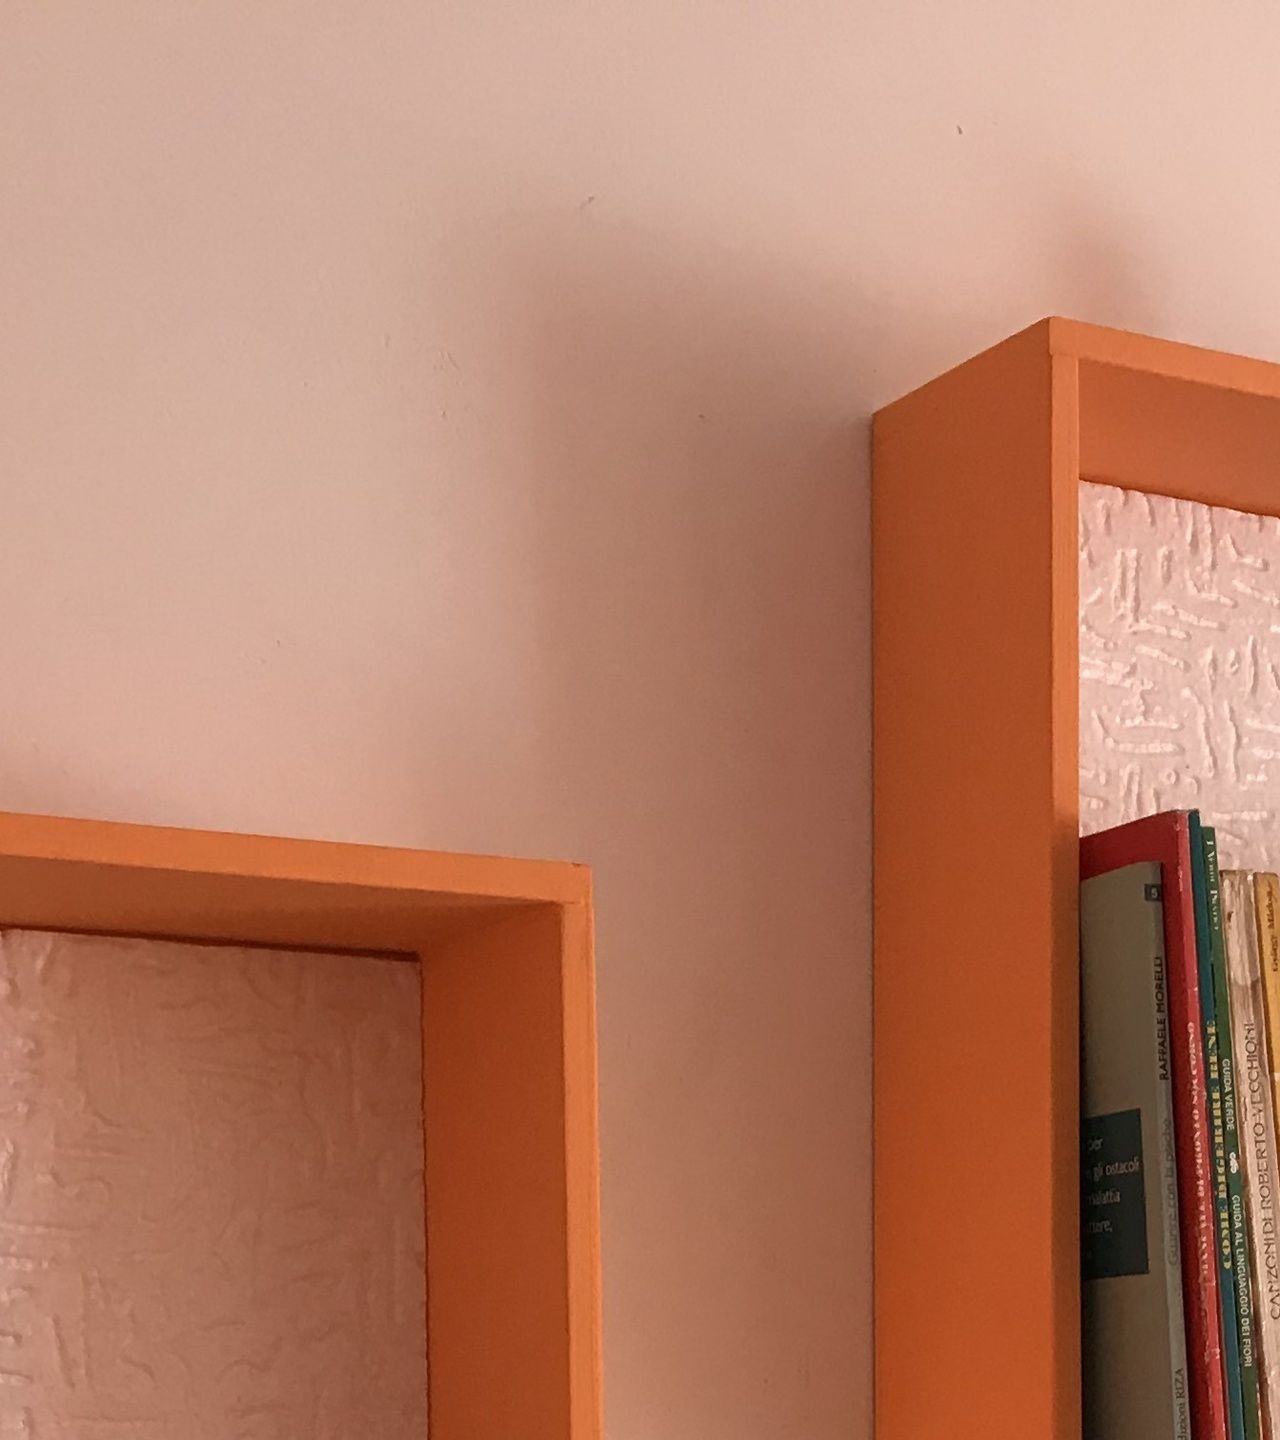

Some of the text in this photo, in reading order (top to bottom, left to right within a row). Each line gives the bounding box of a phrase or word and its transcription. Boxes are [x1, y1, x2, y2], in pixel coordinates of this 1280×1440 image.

[1153, 956, 1170, 1081] RAFFAELE MORELLI
[1222, 1058, 1235, 1131] GUIDA VERDE
[1244, 1021, 1265, 1117] VECCHIONI
[1105, 1156, 1139, 1176] ostacoli
[1252, 1121, 1272, 1214] ROBERTO
[1231, 1194, 1253, 1368] GUIDA AL LINGUAGGIO DEI FIORI
[1174, 1367, 1187, 1399] RIZA
